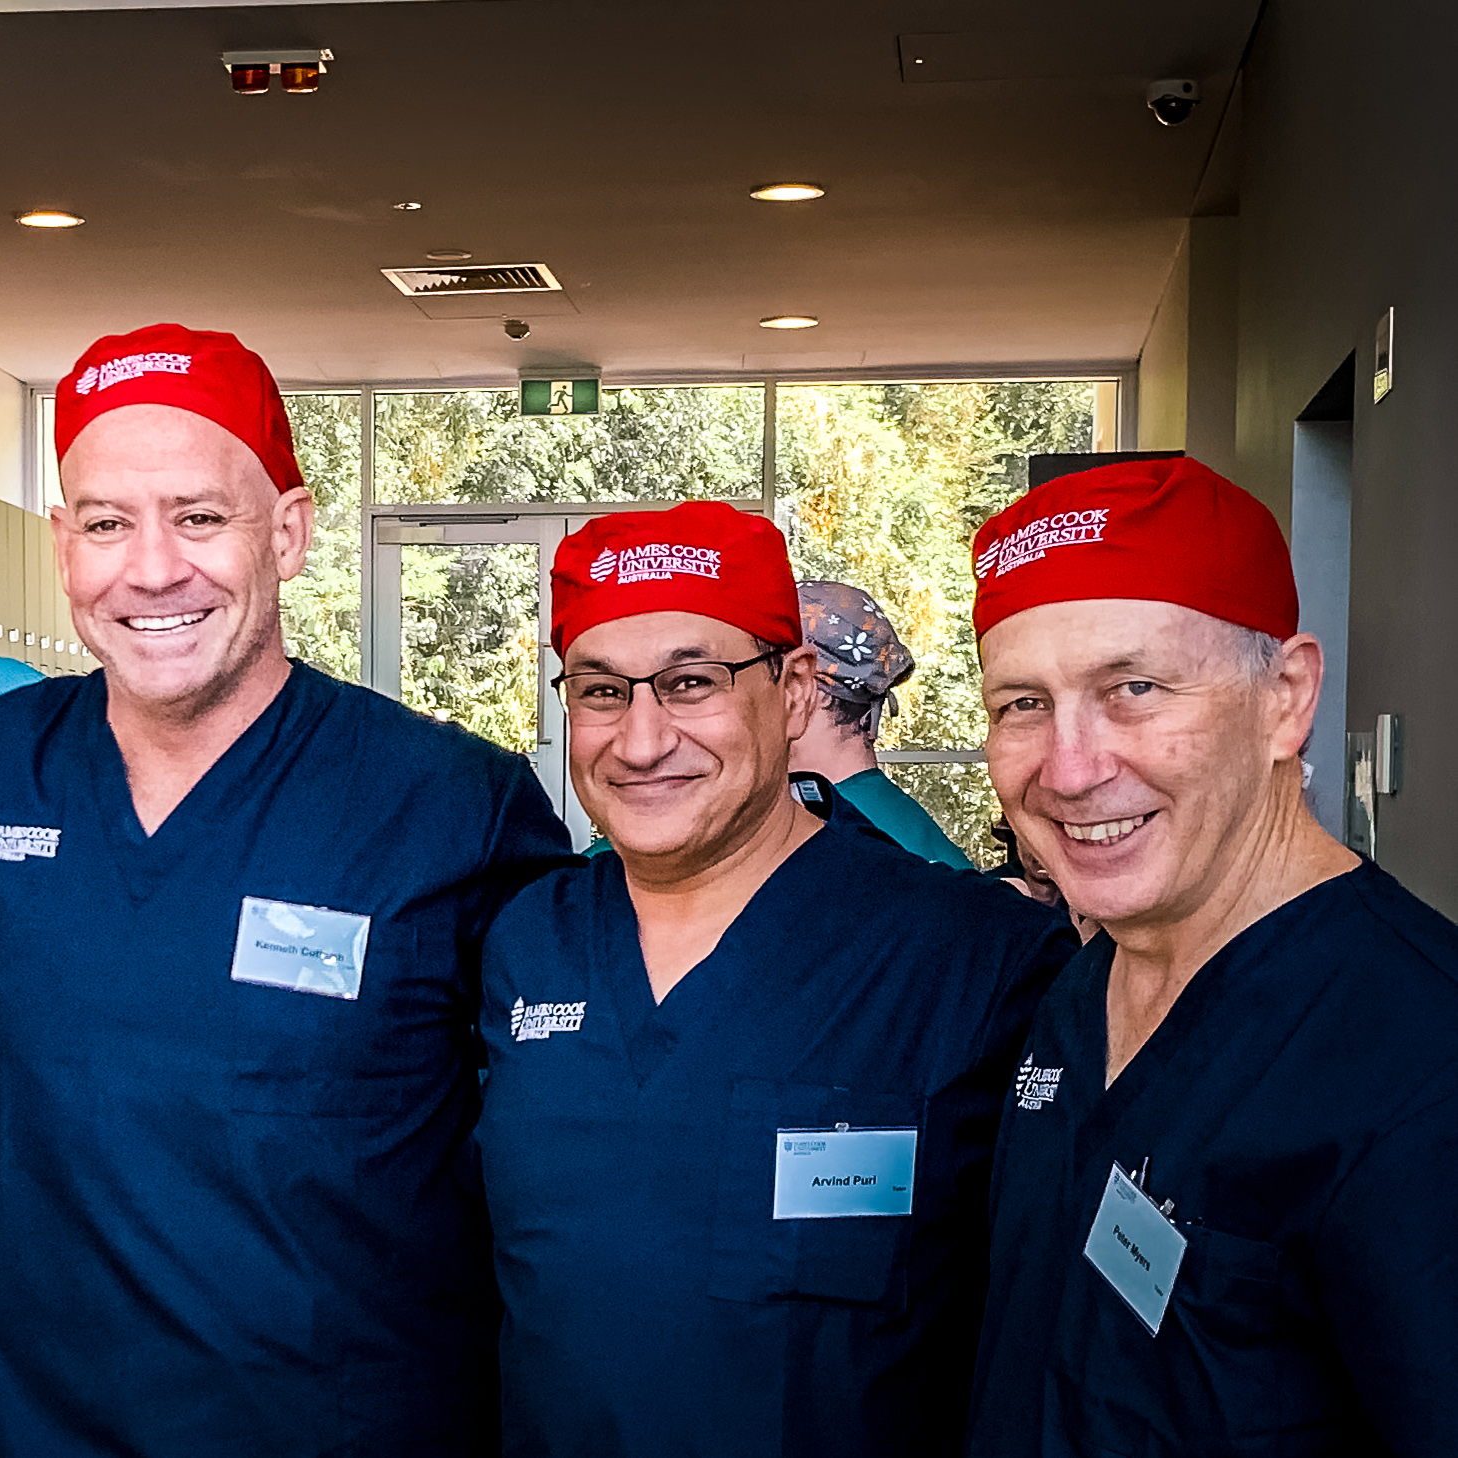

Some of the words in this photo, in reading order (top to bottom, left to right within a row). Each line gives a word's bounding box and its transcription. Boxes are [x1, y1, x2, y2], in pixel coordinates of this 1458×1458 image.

[1002, 517, 1049, 549] JAMES
[1050, 508, 1110, 528] COOK
[620, 544, 669, 561] JAMES
[671, 545, 721, 564] COOK
[999, 524, 1106, 565] UNIVERSITY
[618, 557, 721, 577] UNIVERSITY
[995, 549, 1046, 578] AUSTRALIA
[617, 572, 672, 585] AUSTRALIA
[255, 941, 298, 954] Kenneth
[811, 1176, 850, 1187] Arvind
[853, 1175, 877, 1186] Puri
[1112, 1224, 1131, 1249] Peter
[1130, 1243, 1150, 1271] Myers
